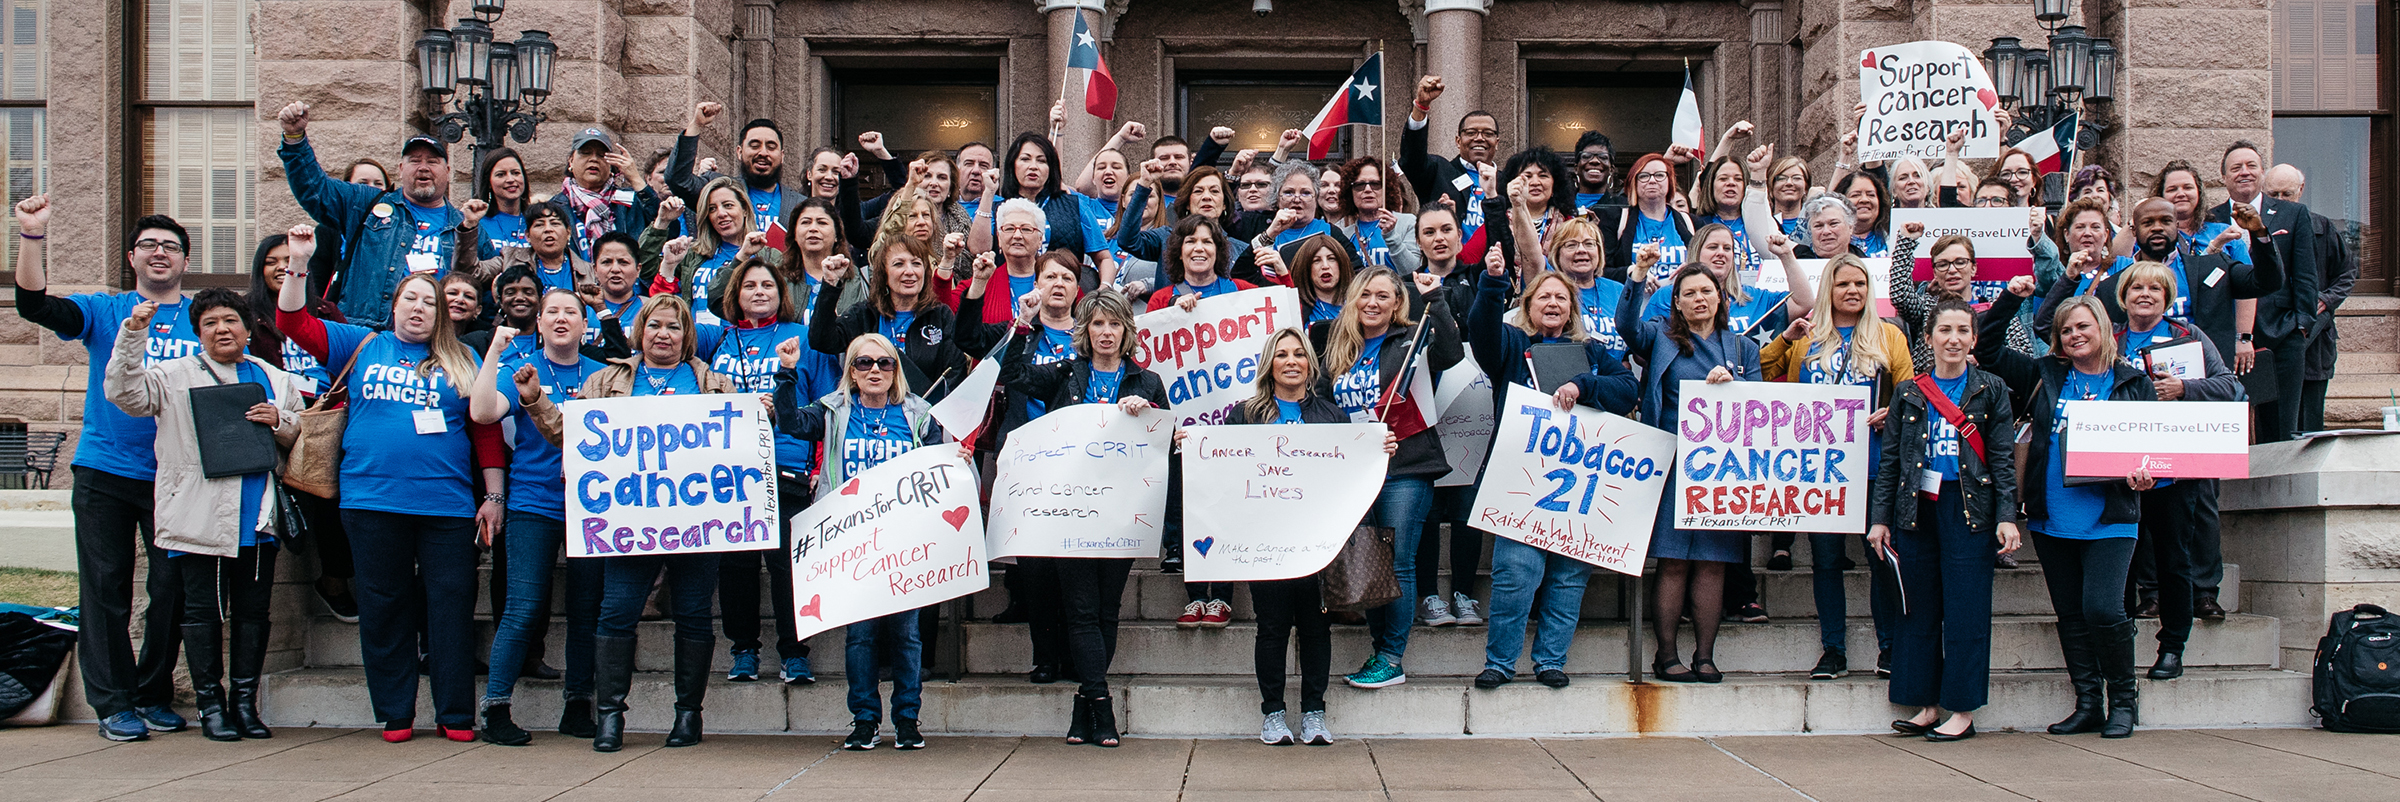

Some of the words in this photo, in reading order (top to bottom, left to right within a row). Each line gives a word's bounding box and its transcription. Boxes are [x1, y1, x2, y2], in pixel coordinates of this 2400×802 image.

[1879, 51, 1972, 90] Support
[1878, 86, 1977, 116] Cancer
[1867, 108, 1987, 147] Research
[145, 337, 199, 357] GHT
[1131, 296, 1278, 371] Support
[363, 363, 443, 390] FIGHT
[1168, 353, 1262, 406] ance
[362, 383, 441, 408] CANCER
[1334, 388, 1381, 408] CANCE
[576, 401, 743, 472] Support
[1680, 397, 1866, 447] SUPPORT
[2075, 421, 2241, 433] #saveCPRITsaveLIVES
[844, 438, 914, 461] FIGHT
[1013, 441, 1076, 466] Protect
[1683, 445, 1849, 484] CANCER
[2150, 461, 2172, 469] Rose
[577, 463, 765, 514] Cancer
[1008, 481, 1043, 500] Fund
[1244, 479, 1304, 500] Lives
[1534, 468, 1599, 515] 21
[1685, 483, 1847, 517] RESEARCH
[581, 505, 770, 555] Research
[1481, 507, 1527, 530] Raise
[1531, 520, 1547, 537] the
[1586, 532, 1635, 558] Prevent
[853, 541, 937, 581] Cancer
[1524, 534, 1555, 550] early
[1560, 544, 1627, 568] addiction
[888, 546, 979, 597] Research
